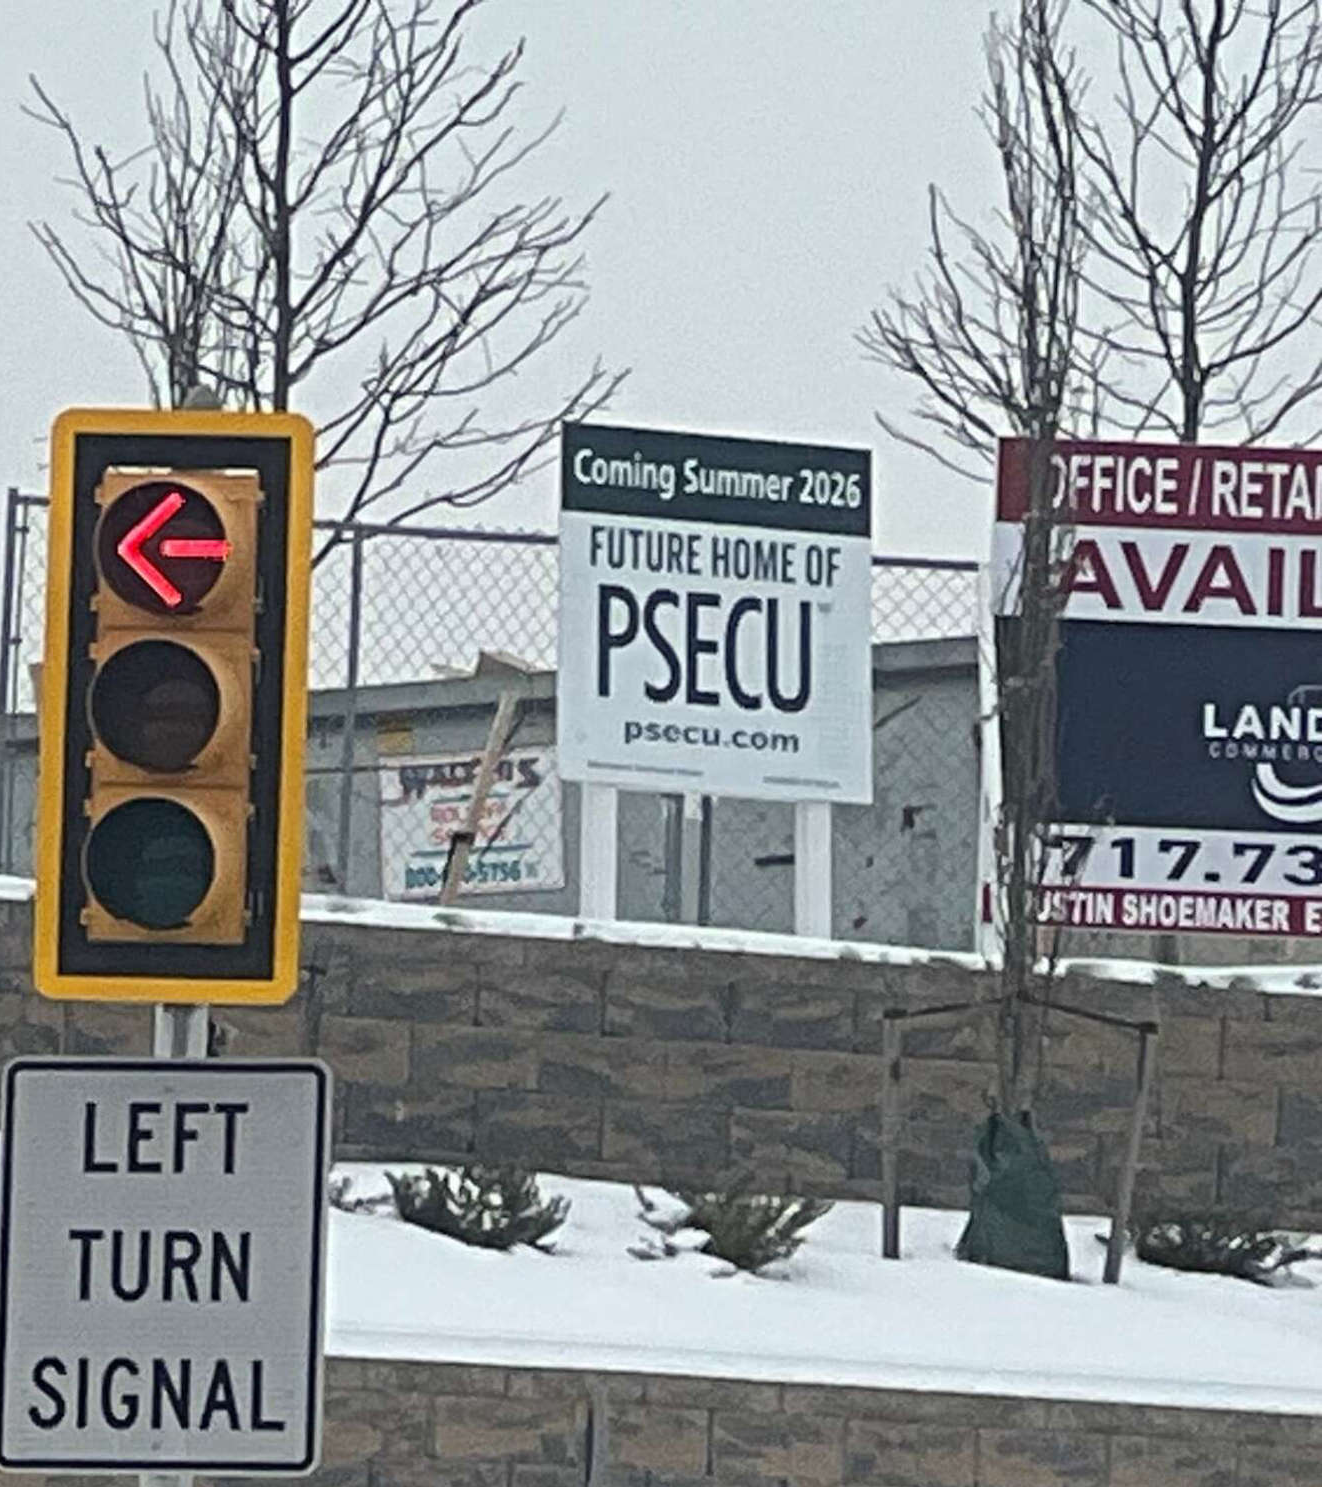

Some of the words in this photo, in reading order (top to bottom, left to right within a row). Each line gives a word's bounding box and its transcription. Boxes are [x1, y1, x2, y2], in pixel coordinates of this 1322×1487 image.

[572, 448, 676, 500] Coming
[683, 458, 793, 502] Summer
[799, 469, 862, 509] 2026
[1188, 457, 1203, 517] /
[590, 525, 703, 576] FUTURE
[711, 535, 796, 585] HOME
[805, 544, 842, 589] OF
[597, 582, 813, 715] PSECU
[624, 720, 800, 754] psecu.com
[1122, 893, 1291, 932] SHOEMAKER
[83, 1101, 249, 1175] LEFT
[69, 1229, 251, 1302] TURN
[28, 1356, 286, 1432] SIGNAL
